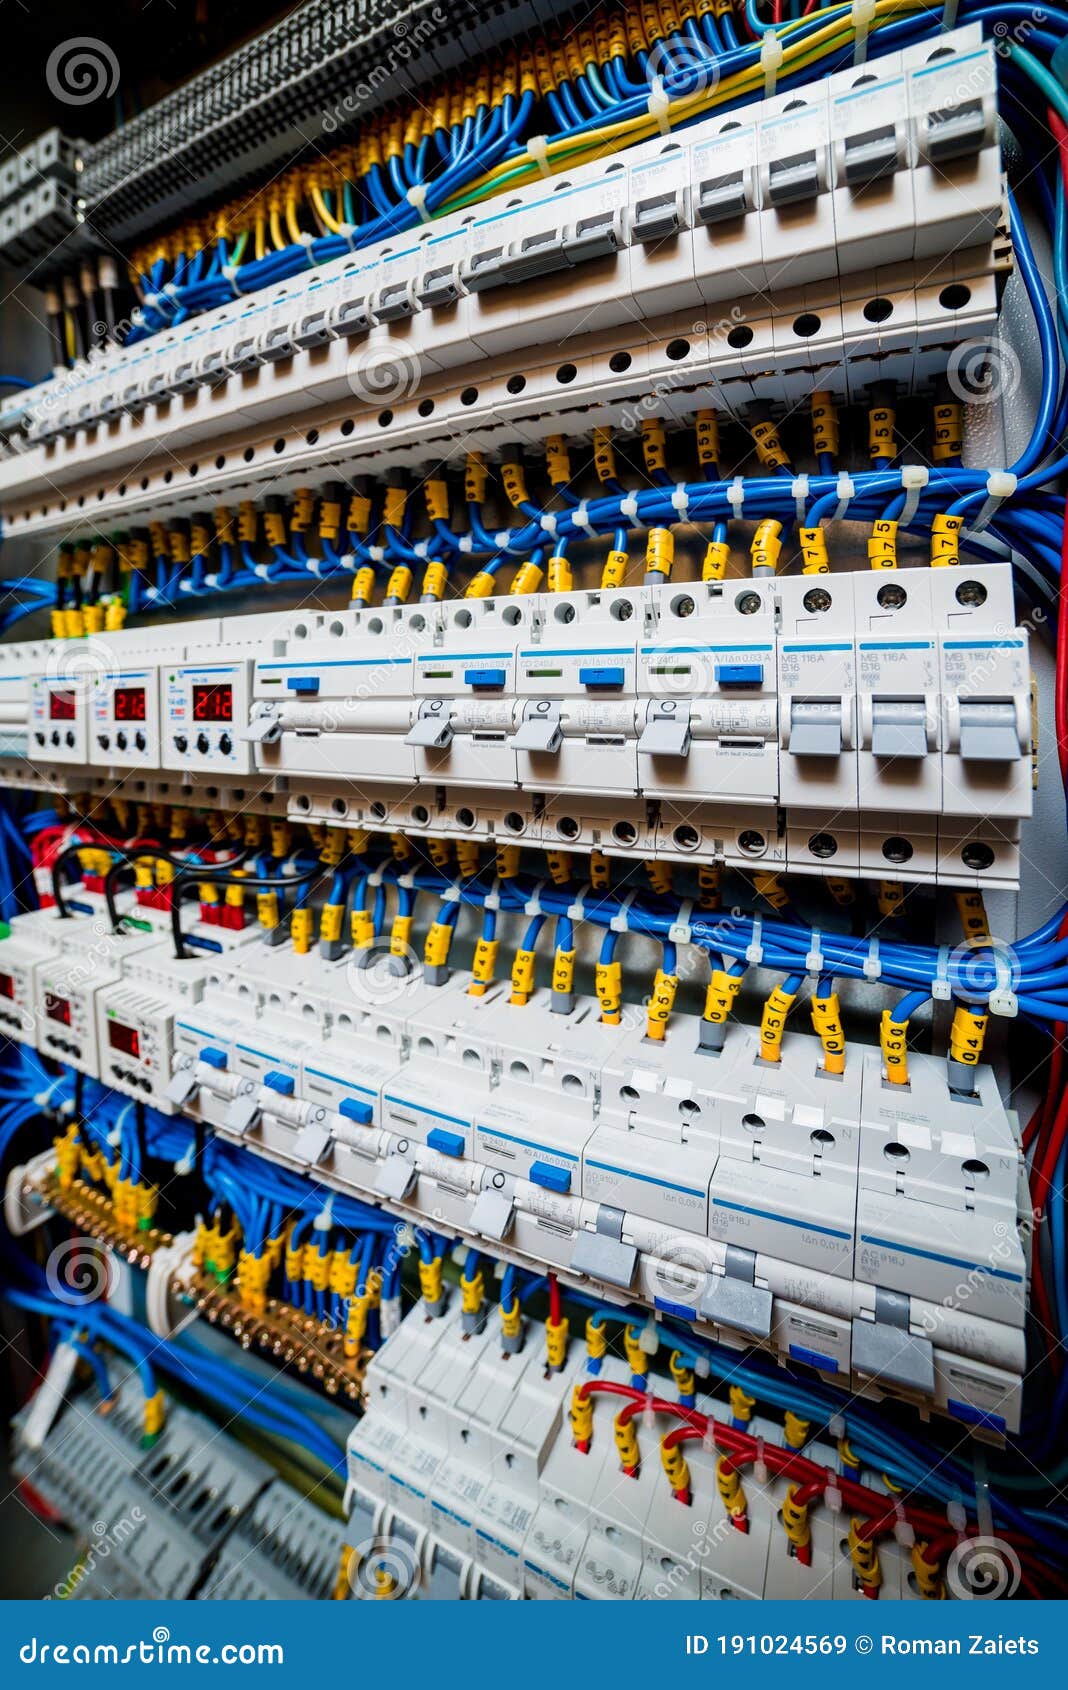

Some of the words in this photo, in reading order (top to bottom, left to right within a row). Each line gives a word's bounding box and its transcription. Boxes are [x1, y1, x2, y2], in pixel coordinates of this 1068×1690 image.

[870, 412, 889, 454] 058
[936, 409, 960, 452] 058
[805, 533, 829, 574] 074
[877, 523, 896, 568] 075
[941, 521, 959, 567] 076
[782, 654, 798, 663] MB
[801, 653, 824, 662] 116A
[782, 663, 800, 671] B16
[861, 653, 878, 662] MB
[883, 653, 907, 661] 116A
[861, 662, 880, 671] B16
[196, 691, 233, 717] 212
[513, 955, 530, 987] 045
[557, 955, 573, 990] 052
[710, 983, 740, 1020] 043
[764, 996, 787, 1040] 051
[817, 1003, 839, 1049] 044
[963, 1020, 985, 1061] 044
[887, 1028, 904, 1064] 050
